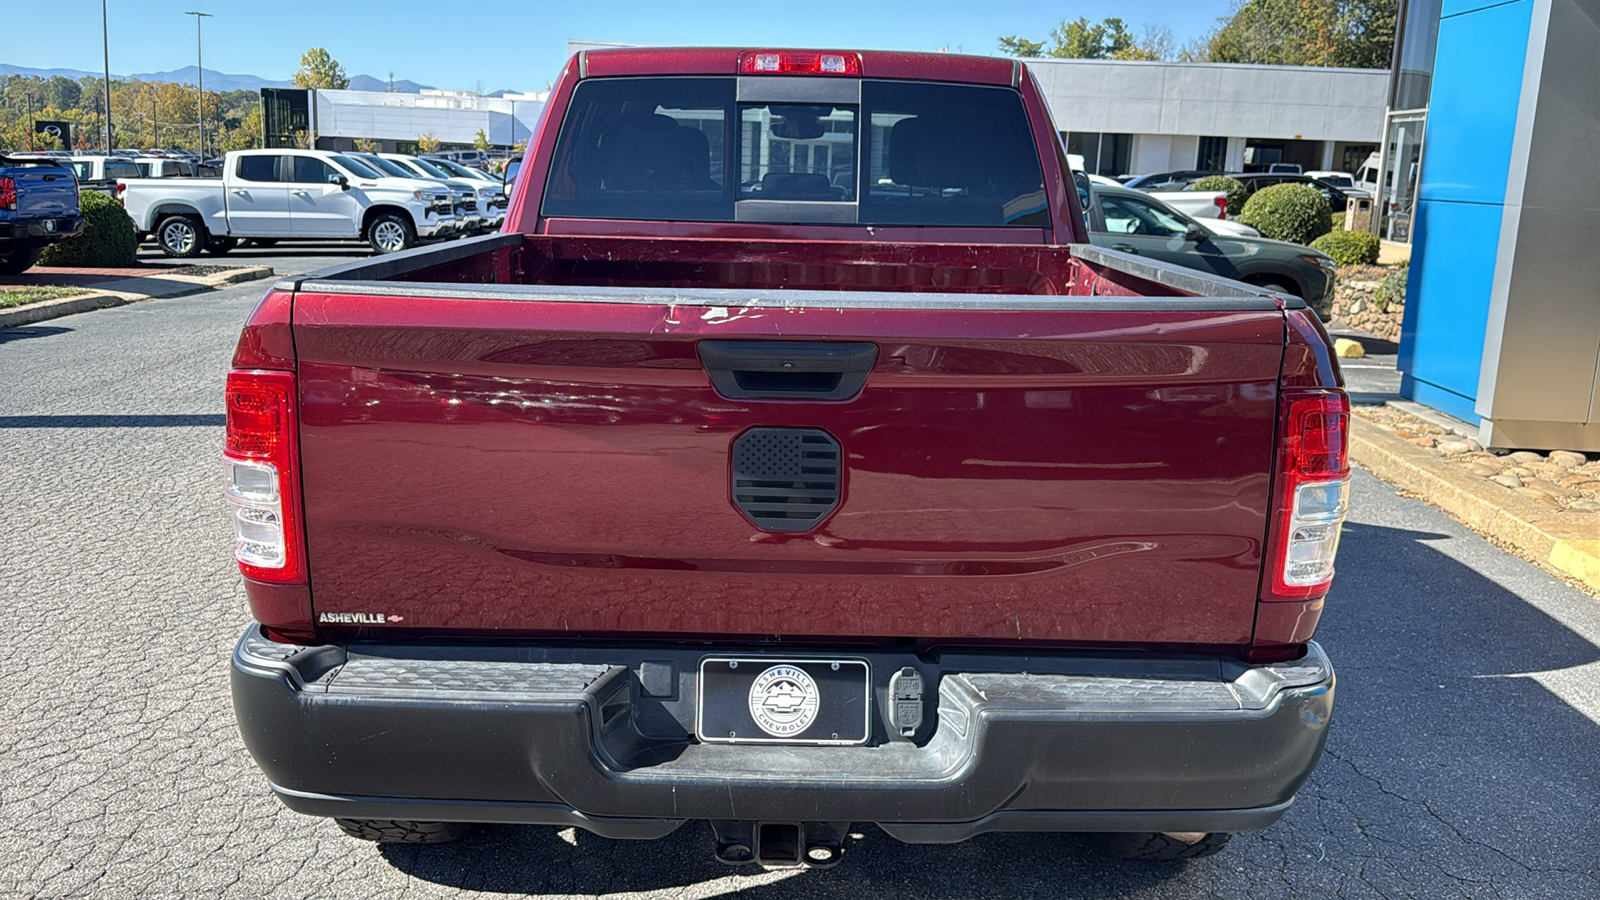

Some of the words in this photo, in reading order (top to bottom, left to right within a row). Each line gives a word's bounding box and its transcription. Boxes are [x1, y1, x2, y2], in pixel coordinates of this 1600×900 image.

[319, 612, 386, 624] ASHEVILLE
[758, 669, 812, 690] ASHEVILLE
[758, 713, 809, 732] CHEVROLET
